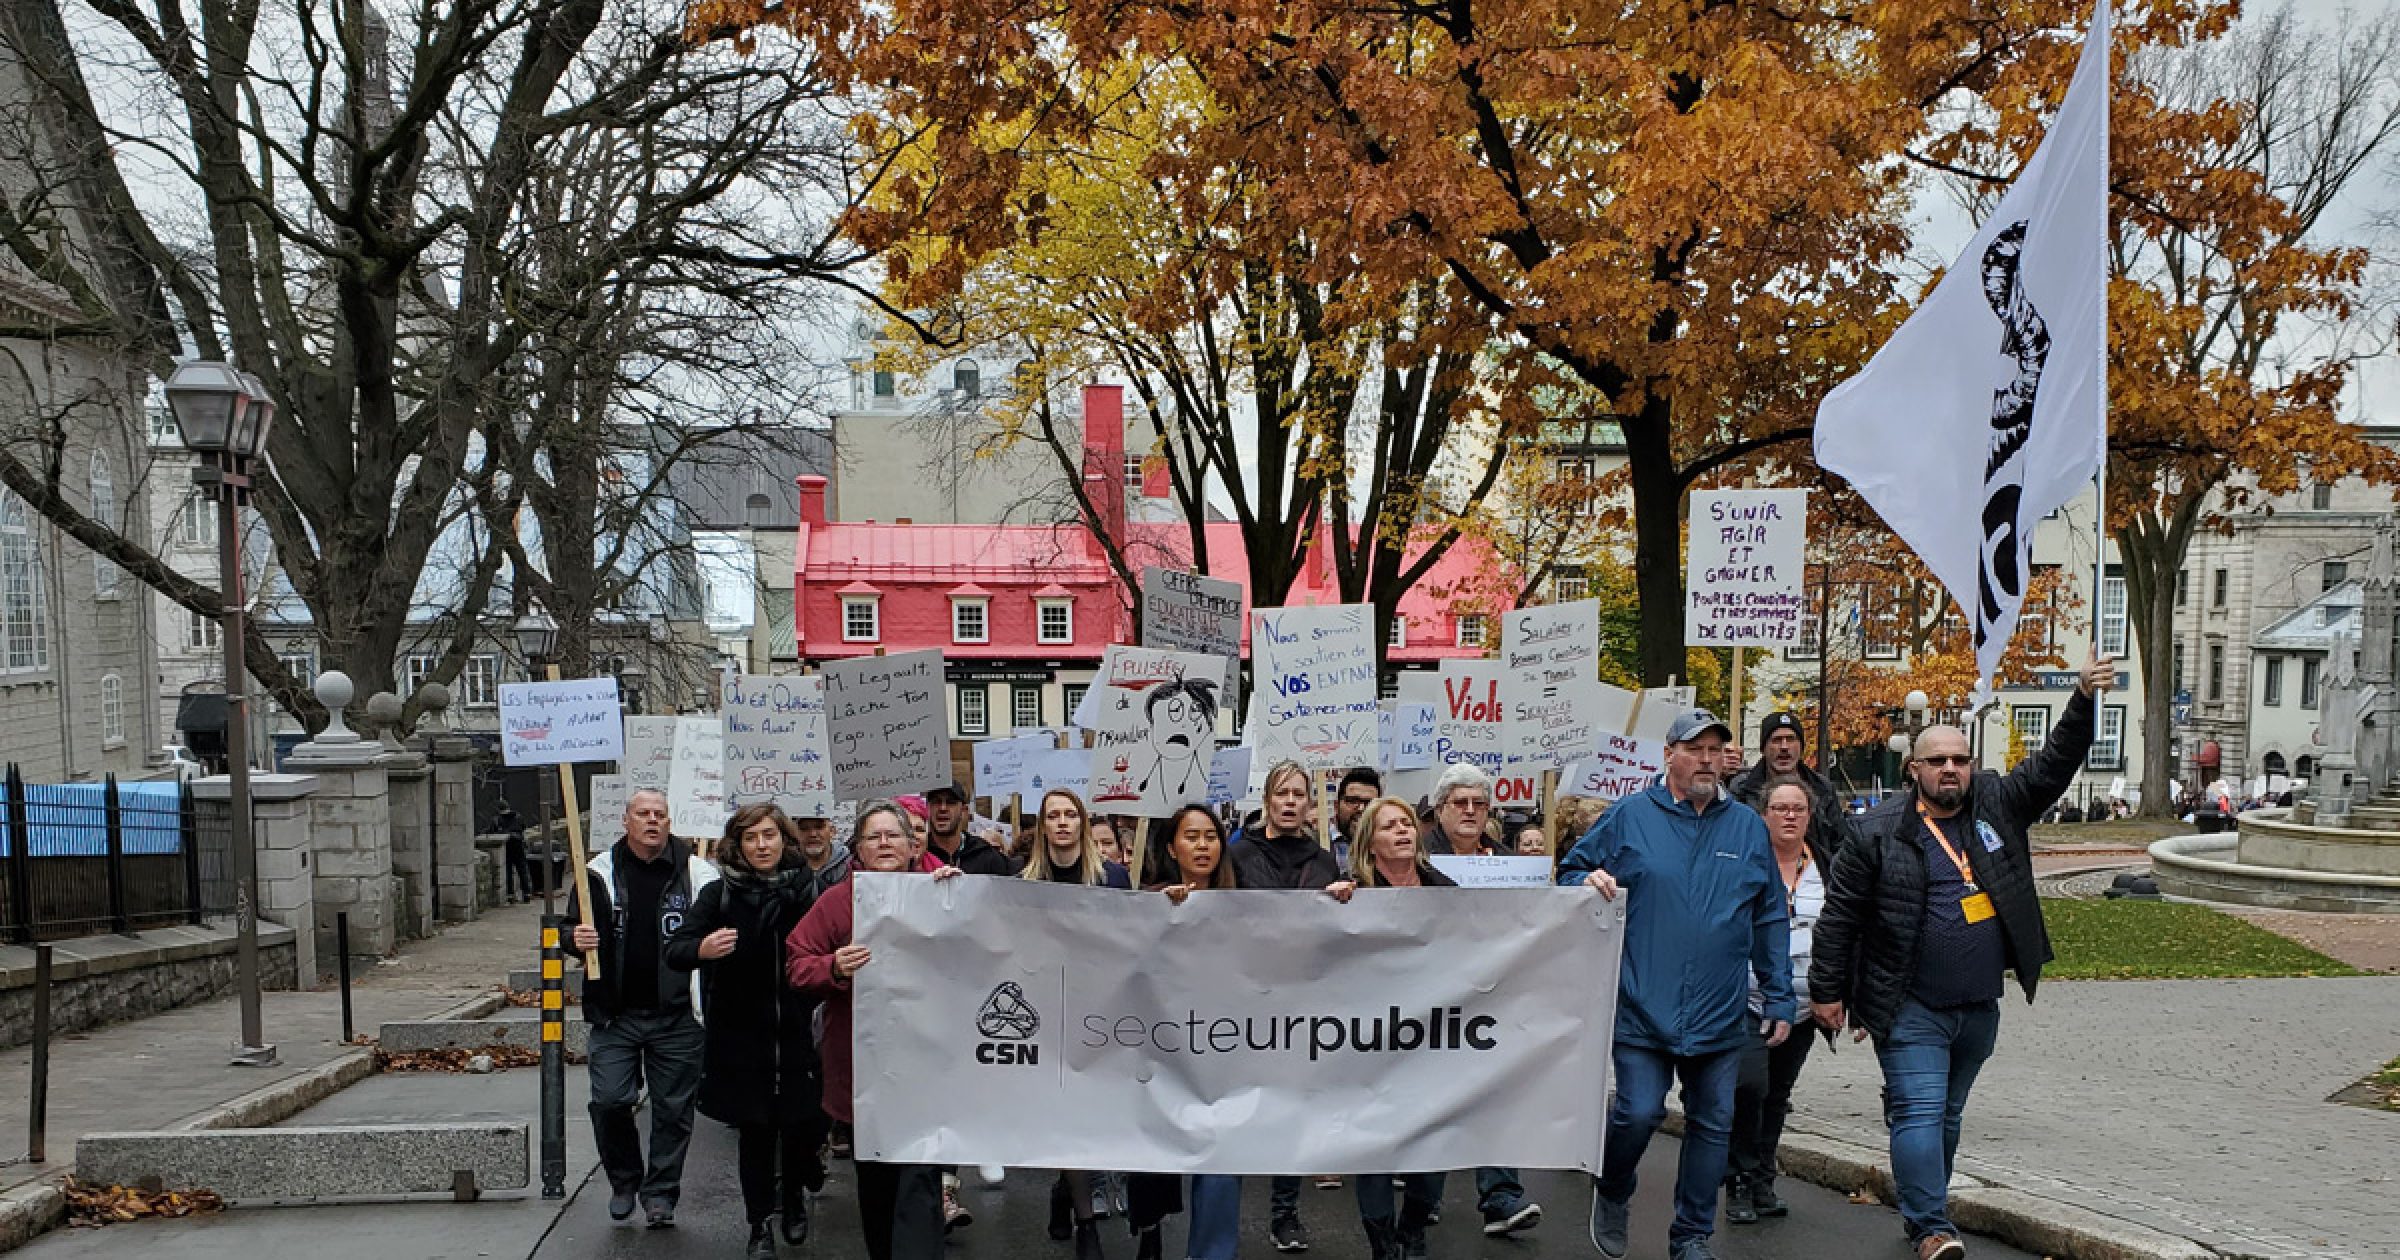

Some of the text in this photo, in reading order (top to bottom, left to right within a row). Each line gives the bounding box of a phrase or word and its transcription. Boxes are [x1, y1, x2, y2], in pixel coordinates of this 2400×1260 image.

[1727, 545, 1753, 565] ET
[1697, 623, 1718, 639] DE
[1271, 672, 1311, 698] VOS
[1443, 676, 1502, 722] Viole
[1081, 1005, 1498, 1061] secteurpublic
[975, 1042, 1039, 1065] CSN
